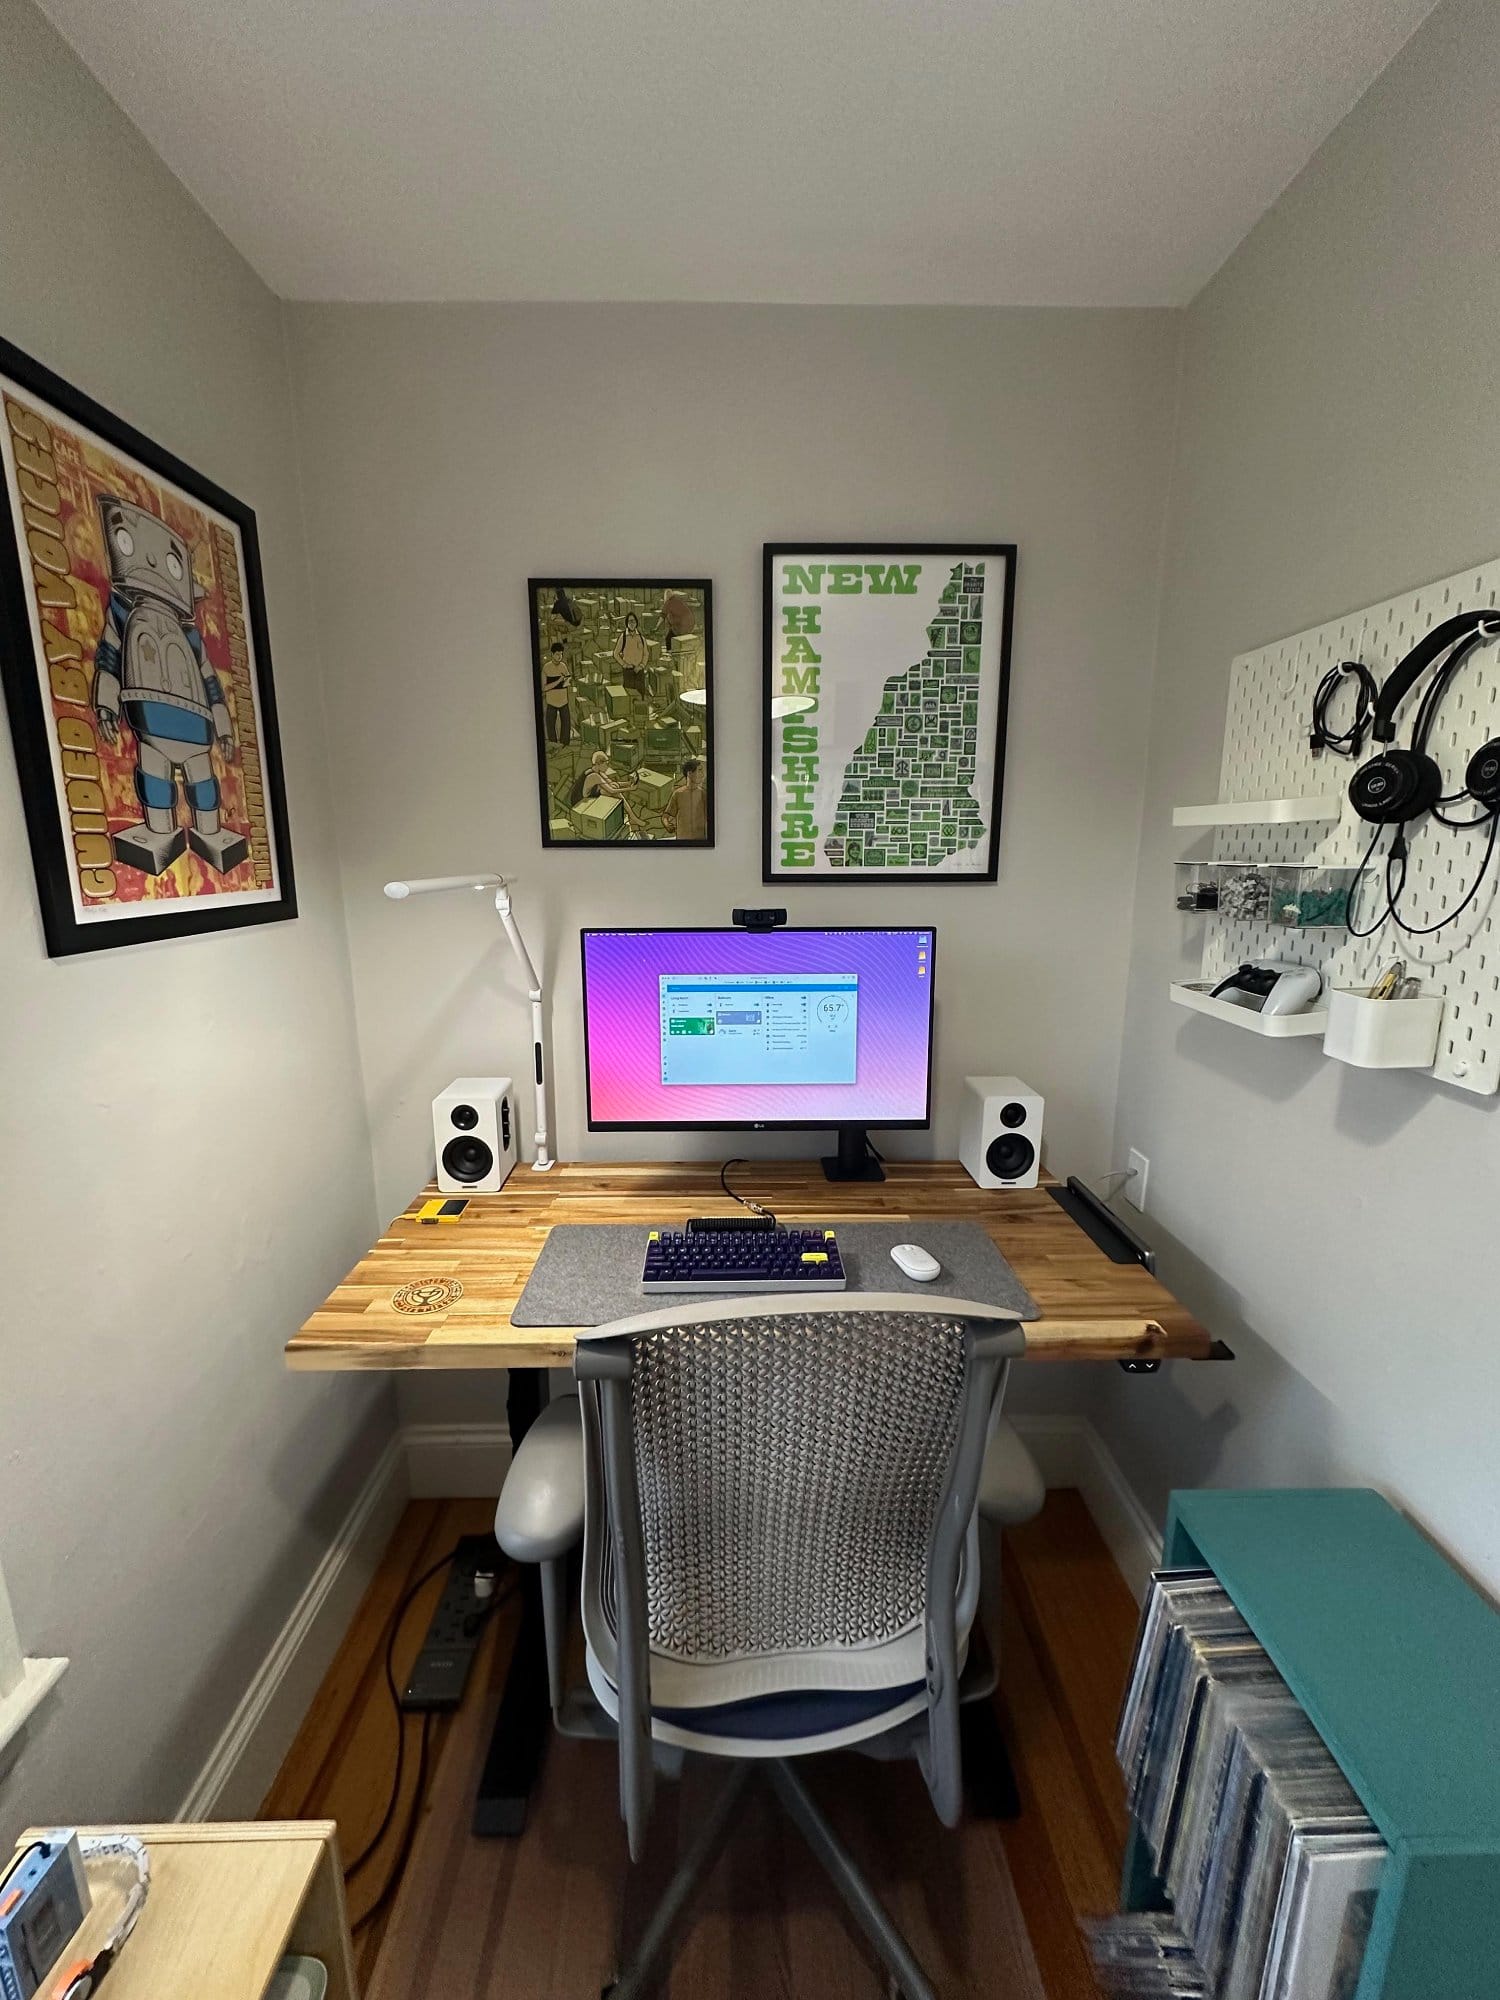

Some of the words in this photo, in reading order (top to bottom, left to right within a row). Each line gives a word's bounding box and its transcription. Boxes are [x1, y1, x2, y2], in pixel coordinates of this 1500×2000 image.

[5, 401, 77, 609] VOICES
[782, 564, 922, 594] NEW
[41, 619, 90, 706] BY
[57, 717, 117, 898] GUIDED
